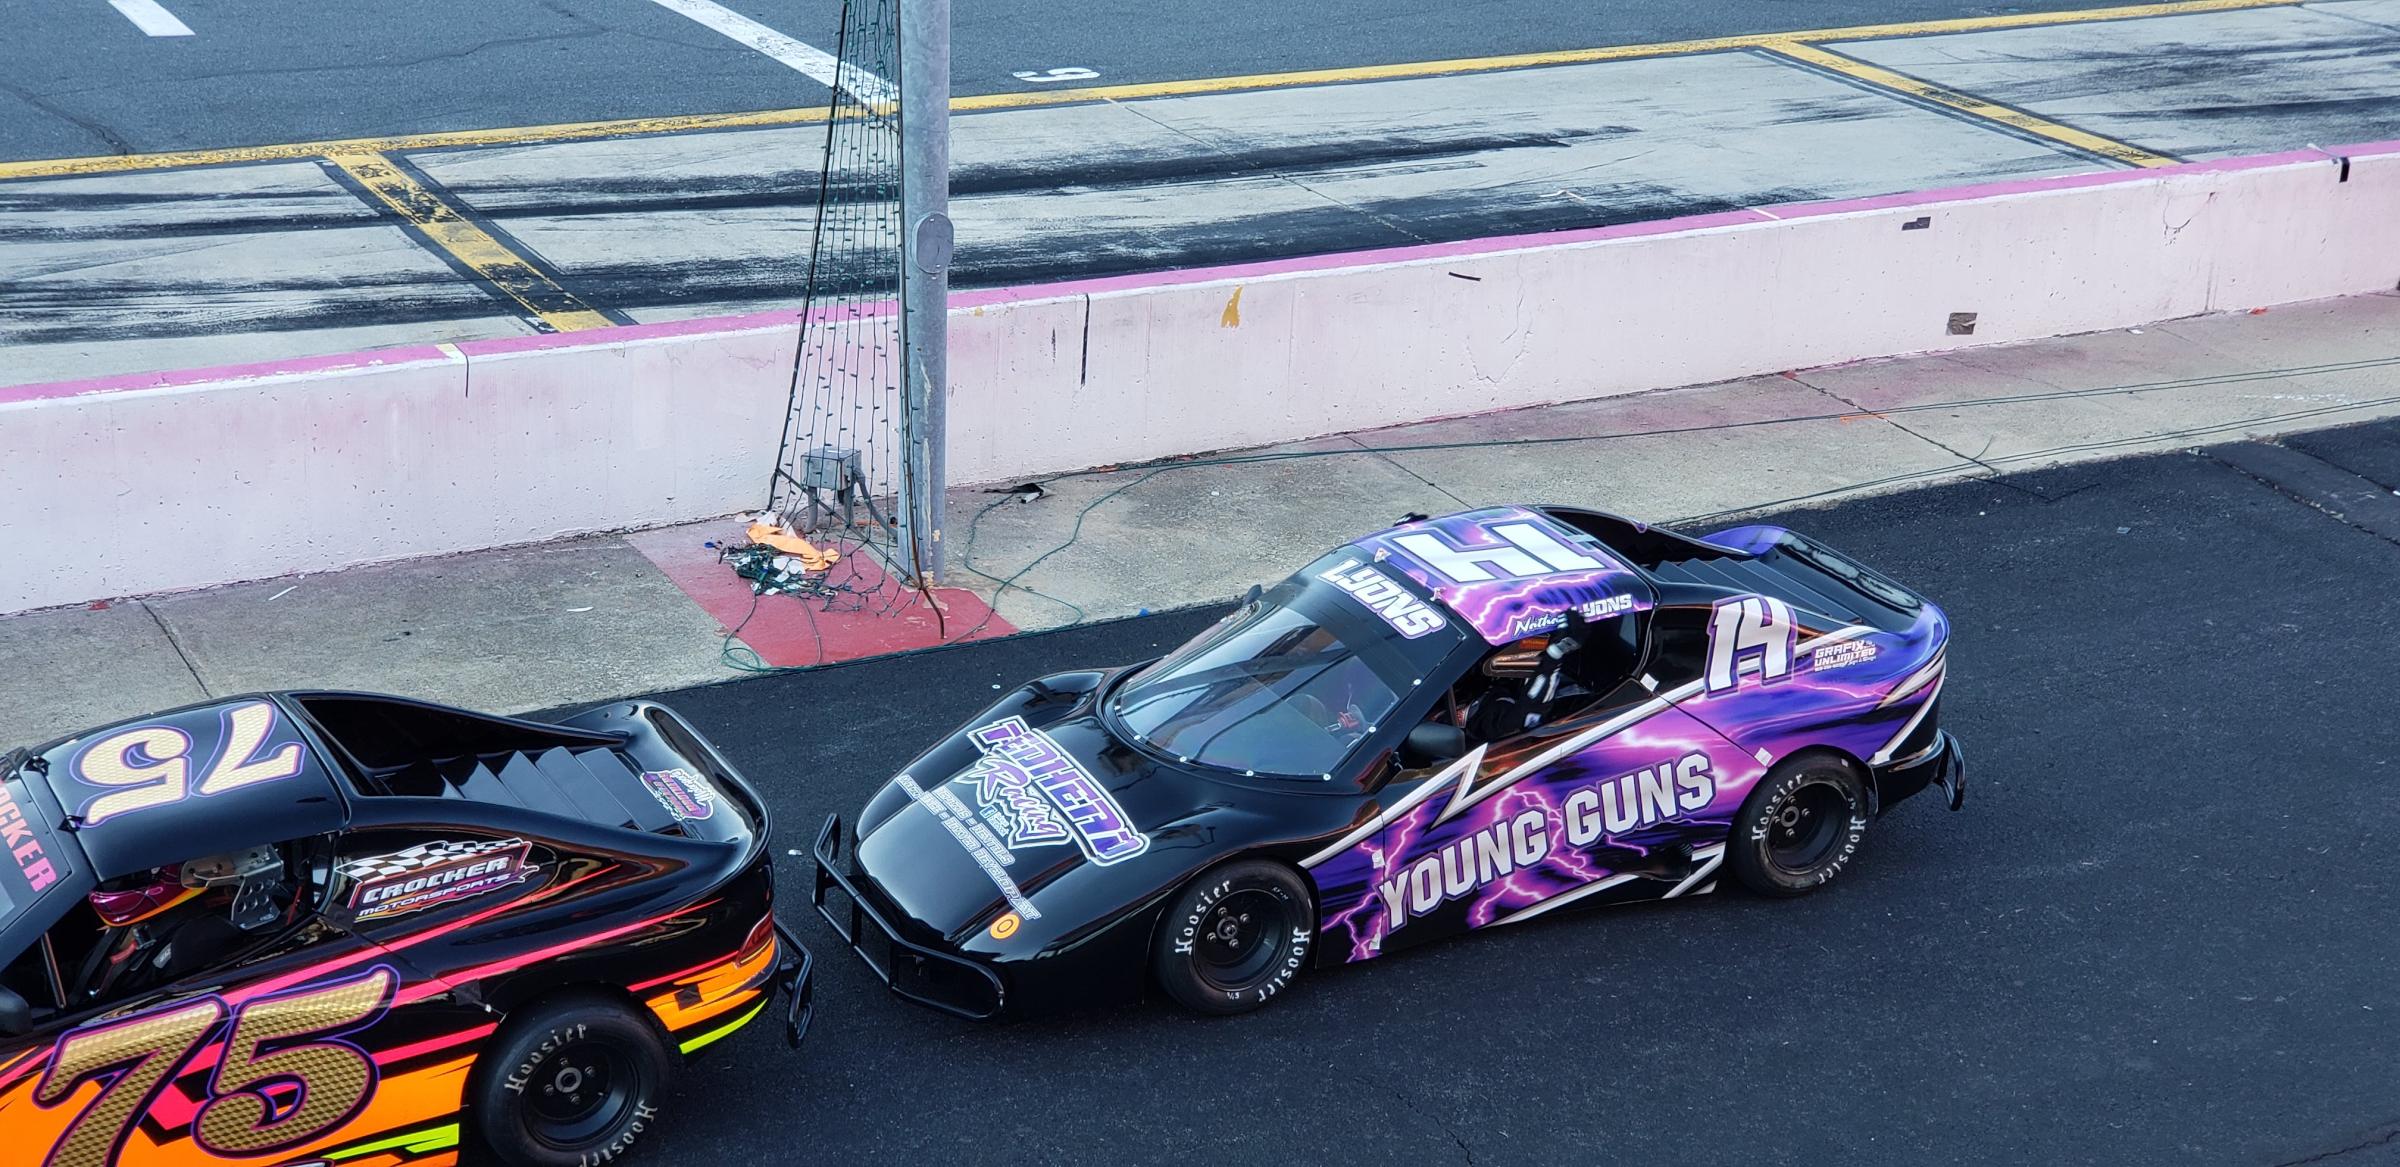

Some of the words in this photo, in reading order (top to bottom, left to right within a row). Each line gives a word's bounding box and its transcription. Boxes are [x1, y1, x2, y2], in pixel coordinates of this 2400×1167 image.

[1316, 558, 1448, 640] LYONS
[1570, 593, 1632, 620] YONS
[1703, 596, 1797, 698] 14
[1814, 647, 1877, 667] UNLIMITED
[1815, 640, 1865, 659] GRAFIX
[69, 699, 306, 828] 75
[955, 752, 1074, 850] Racing
[1751, 773, 1804, 841] Hoosier
[1378, 806, 1550, 933] YOUNG
[1563, 750, 1718, 850] GUNS
[1818, 815, 1866, 886] Hoosier
[358, 872, 512, 917] MOTORSPORTS
[362, 856, 512, 904] CROCKER
[1174, 879, 1231, 955] Hoosier
[1258, 926, 1311, 1003] Hoosier
[32, 961, 400, 1167] 75
[504, 1023, 586, 1096] Hoosier
[579, 1099, 658, 1167] Hoosier
